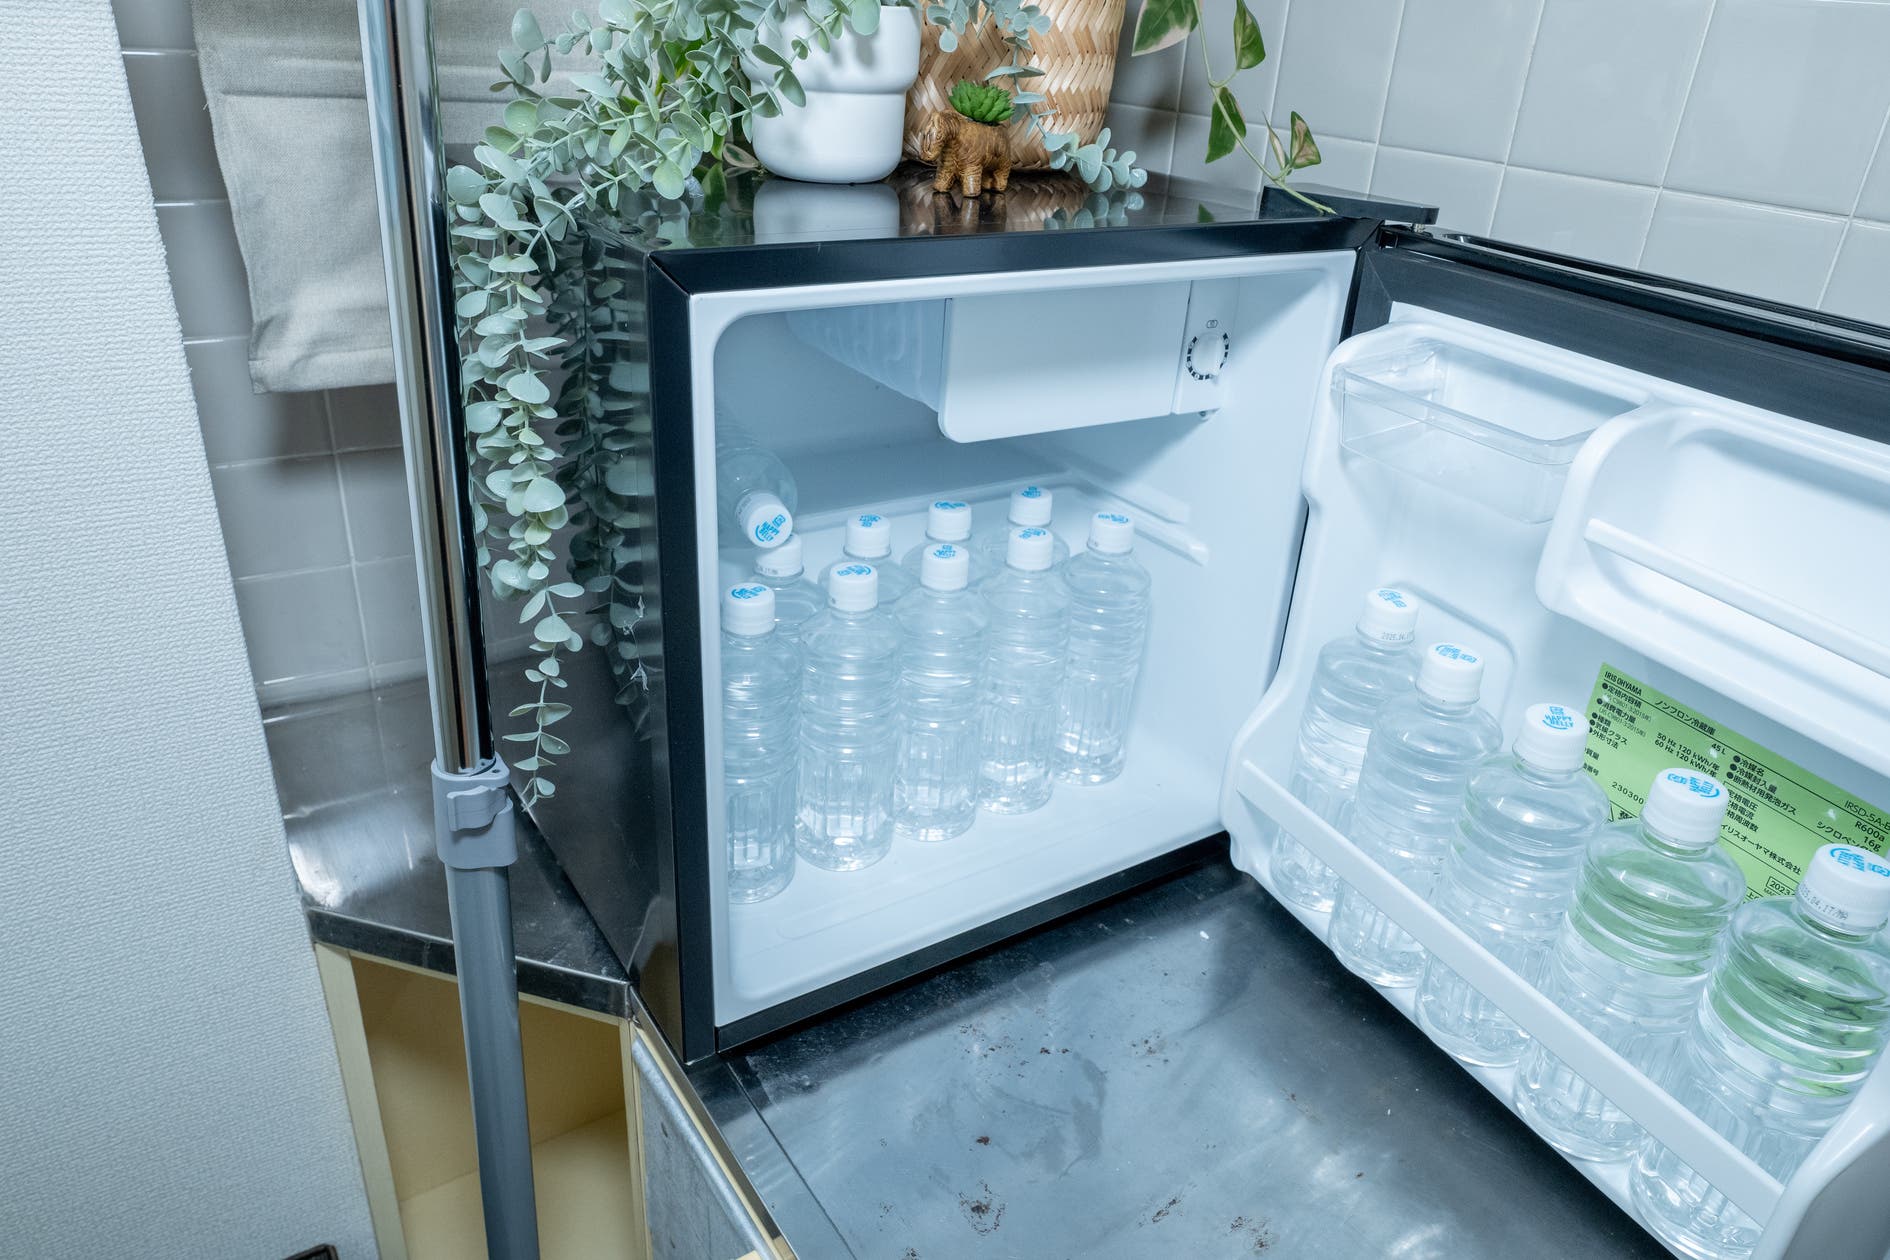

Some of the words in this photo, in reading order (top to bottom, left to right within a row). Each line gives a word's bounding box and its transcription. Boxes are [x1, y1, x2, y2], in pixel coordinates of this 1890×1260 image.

[1604, 671, 1617, 683] IRIS
[1616, 677, 1642, 697] OHYAMA
[1655, 700, 1716, 736] ノンフロン冷蔵庫
[1654, 739, 1665, 748] 60
[1664, 744, 1675, 754] Hz
[1676, 751, 1689, 762] 120
[1656, 732, 1667, 742] 50
[1667, 738, 1677, 748] Hz
[1679, 744, 1692, 756] 120
[1740, 758, 1765, 777] 冷媒名
[1736, 766, 1778, 795] 冷媒封入量
[1733, 775, 1797, 816] 断熱材用発泡ガス
[1727, 809, 1759, 833] 格周波数
[1728, 799, 1755, 820] 格電流
[1854, 820, 1886, 842] R600a
[1863, 836, 1882, 853] 16g
